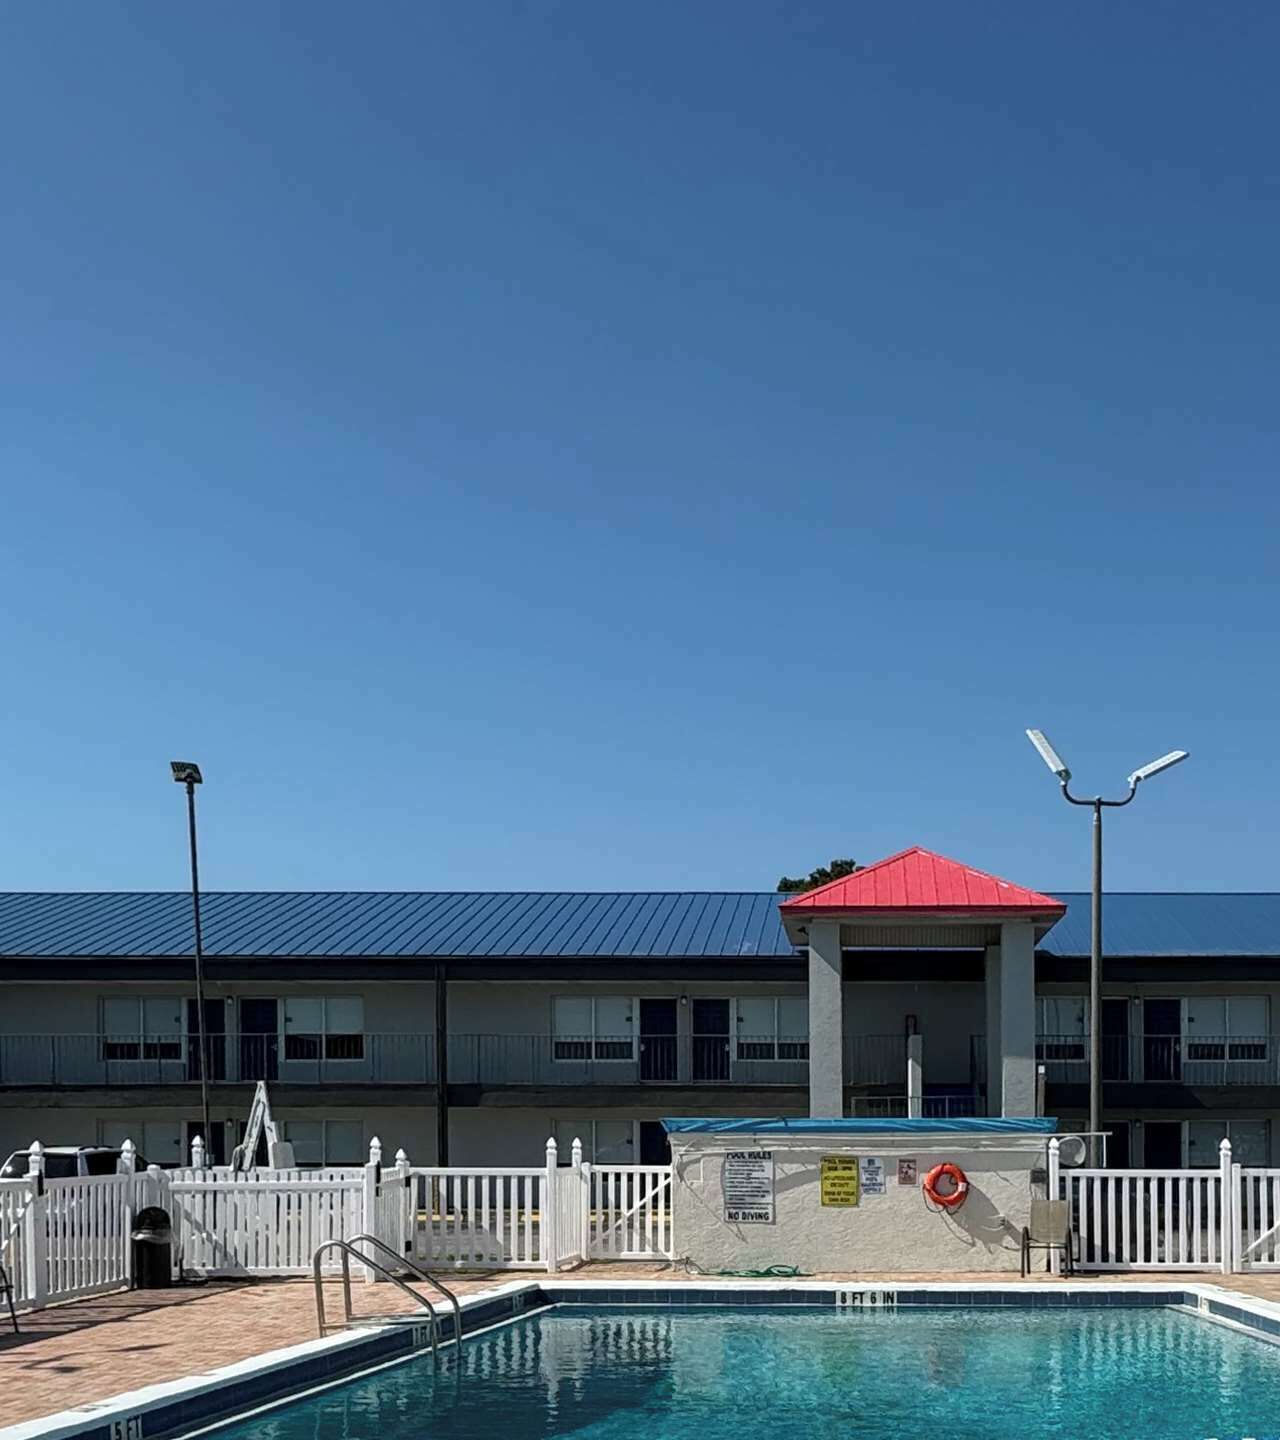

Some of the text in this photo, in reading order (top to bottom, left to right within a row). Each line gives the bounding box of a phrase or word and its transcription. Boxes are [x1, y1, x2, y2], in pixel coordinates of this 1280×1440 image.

[728, 1211, 770, 1221] NO DIVING
[840, 1291, 895, 1305] 8 FT 6 IN
[127, 1414, 140, 1440] FT
